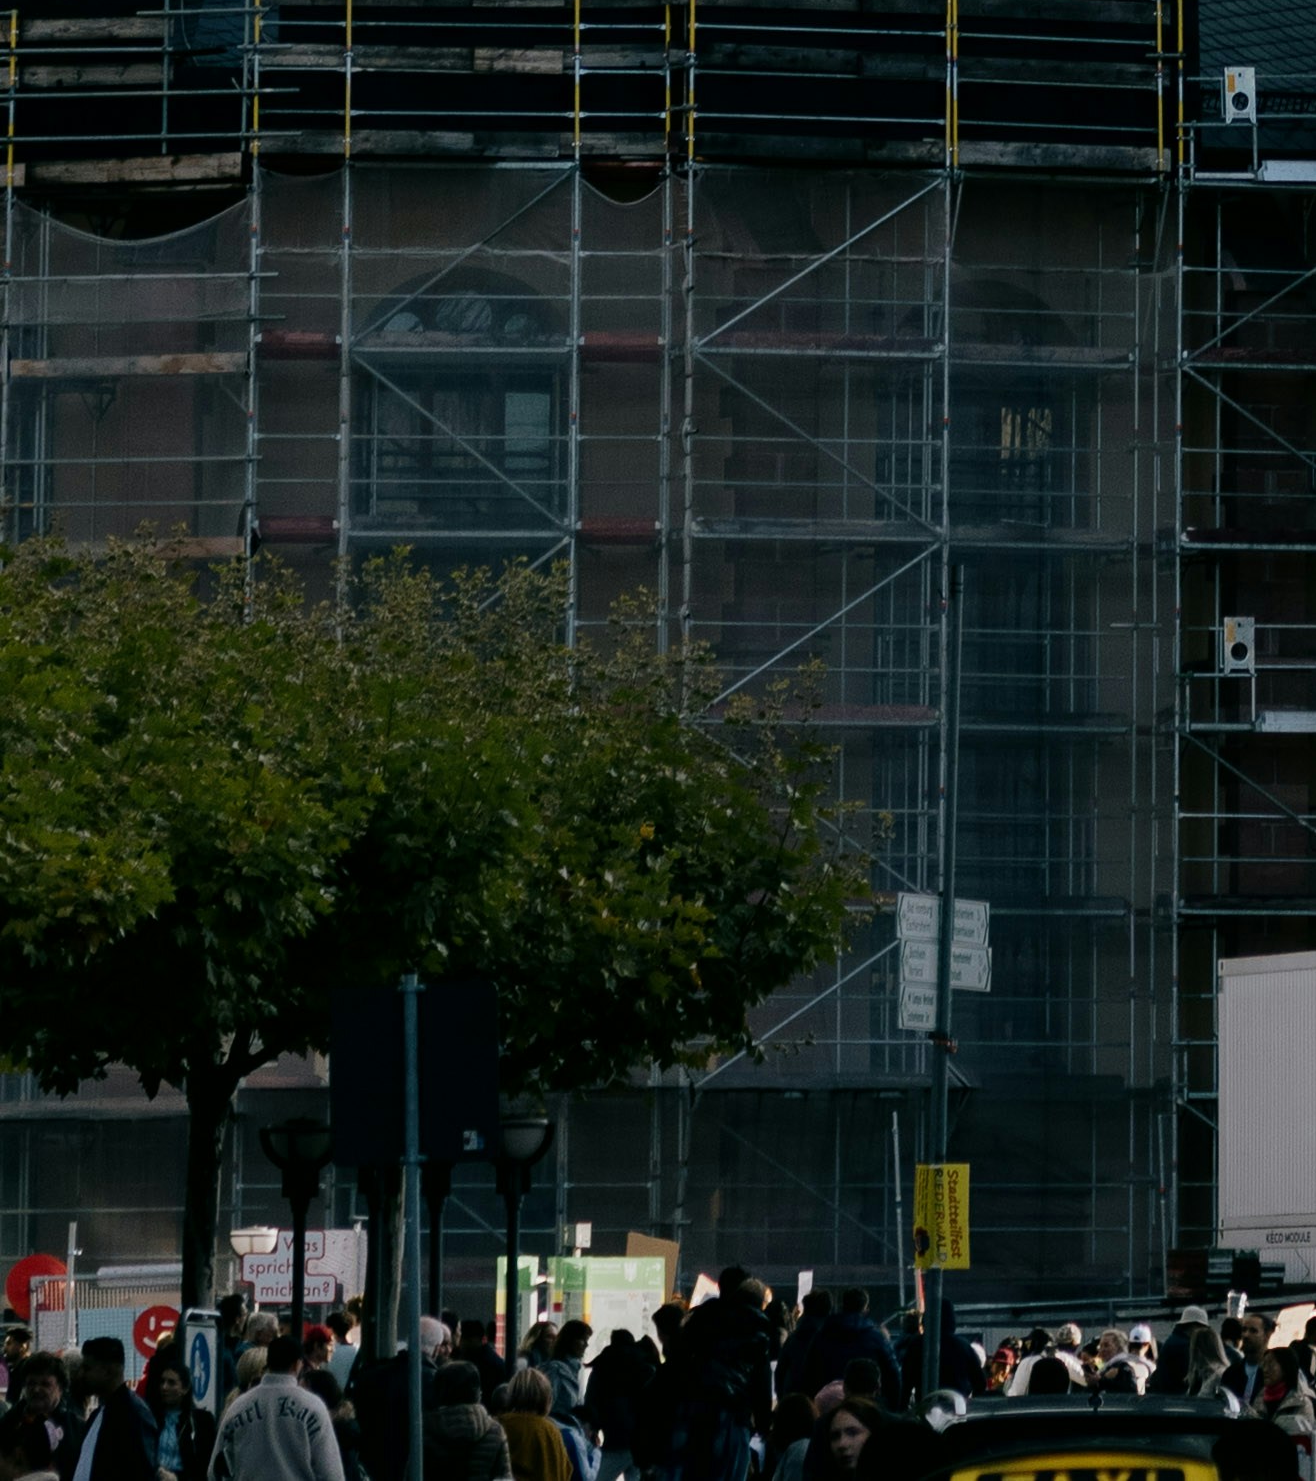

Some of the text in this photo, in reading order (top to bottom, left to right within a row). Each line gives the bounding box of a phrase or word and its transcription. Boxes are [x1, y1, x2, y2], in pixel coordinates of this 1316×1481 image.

[947, 1169, 962, 1259] Stadtteilfest
[1266, 1230, 1311, 1244] KÉCO MODULE
[249, 1258, 294, 1277] sprich
